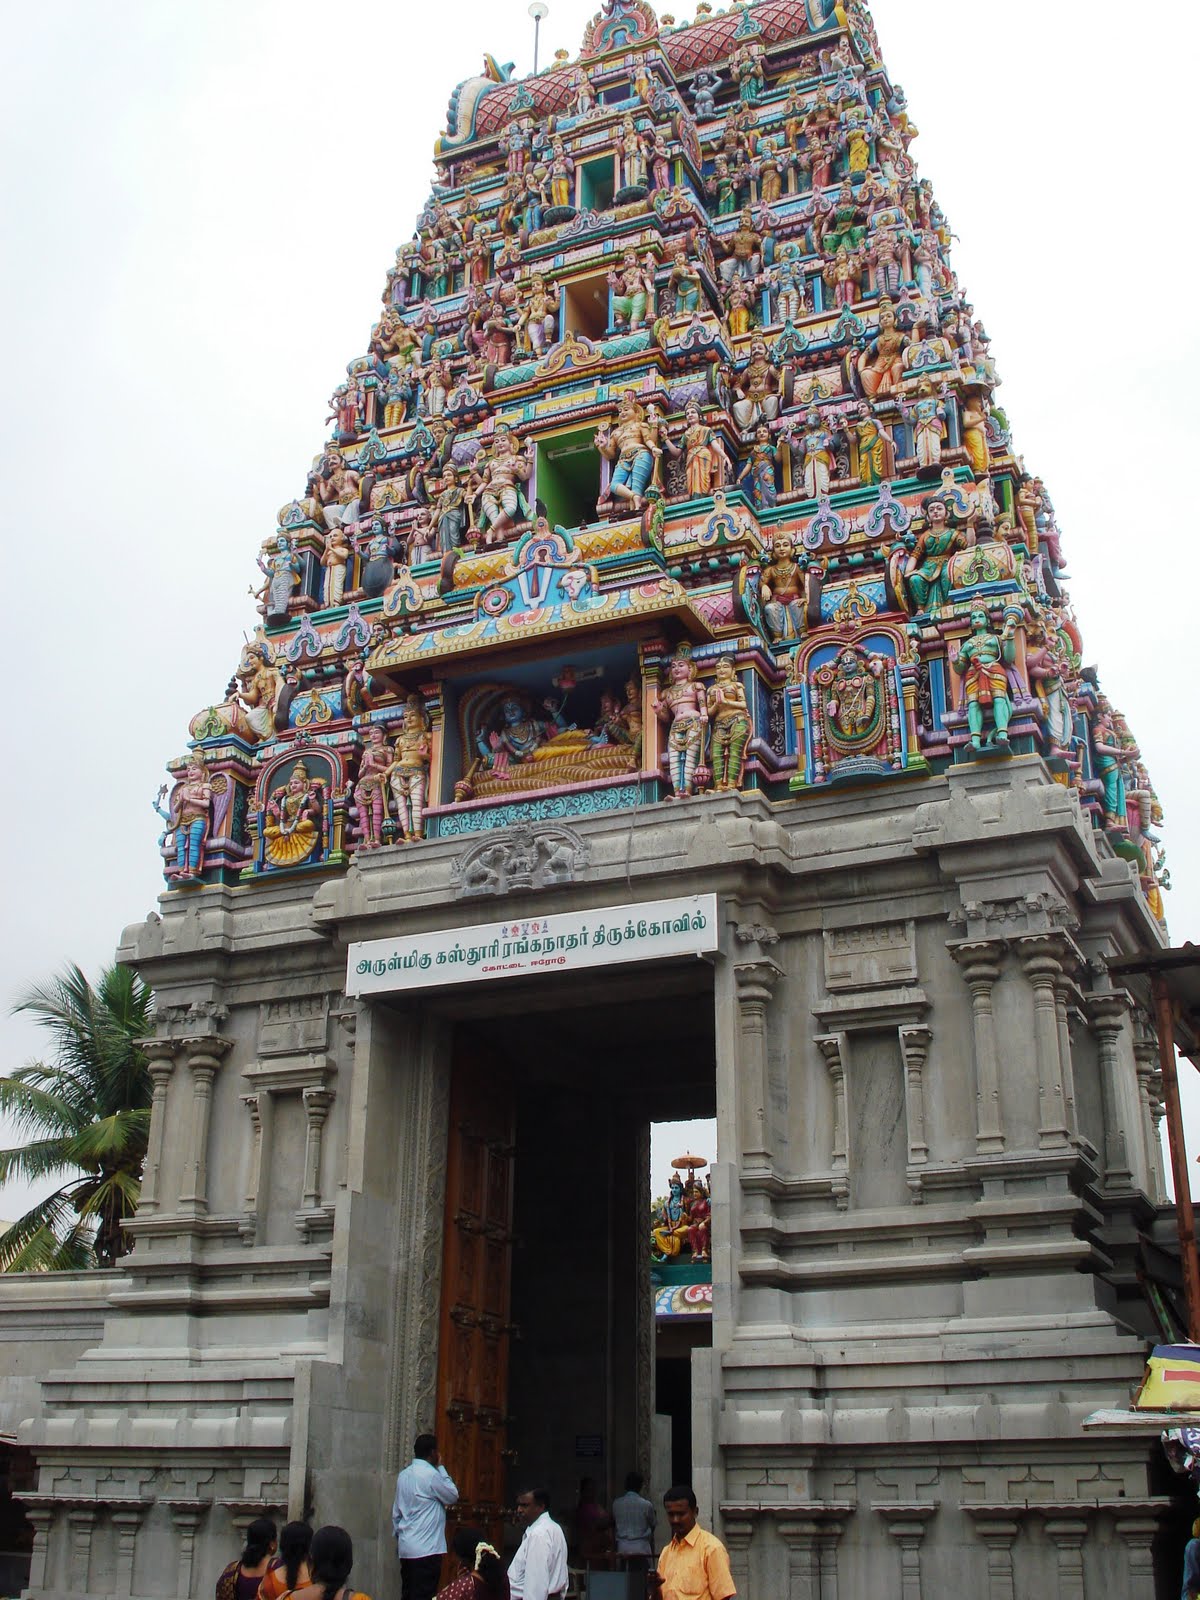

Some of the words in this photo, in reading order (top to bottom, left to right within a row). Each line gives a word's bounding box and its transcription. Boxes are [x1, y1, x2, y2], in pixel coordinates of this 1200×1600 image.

[356, 950, 432, 976] அருள்மிகு
[436, 939, 500, 966] கஸ்தூரி
[502, 926, 589, 958] ரங்கநாதர்
[592, 909, 707, 948] திருக்கோவில்
